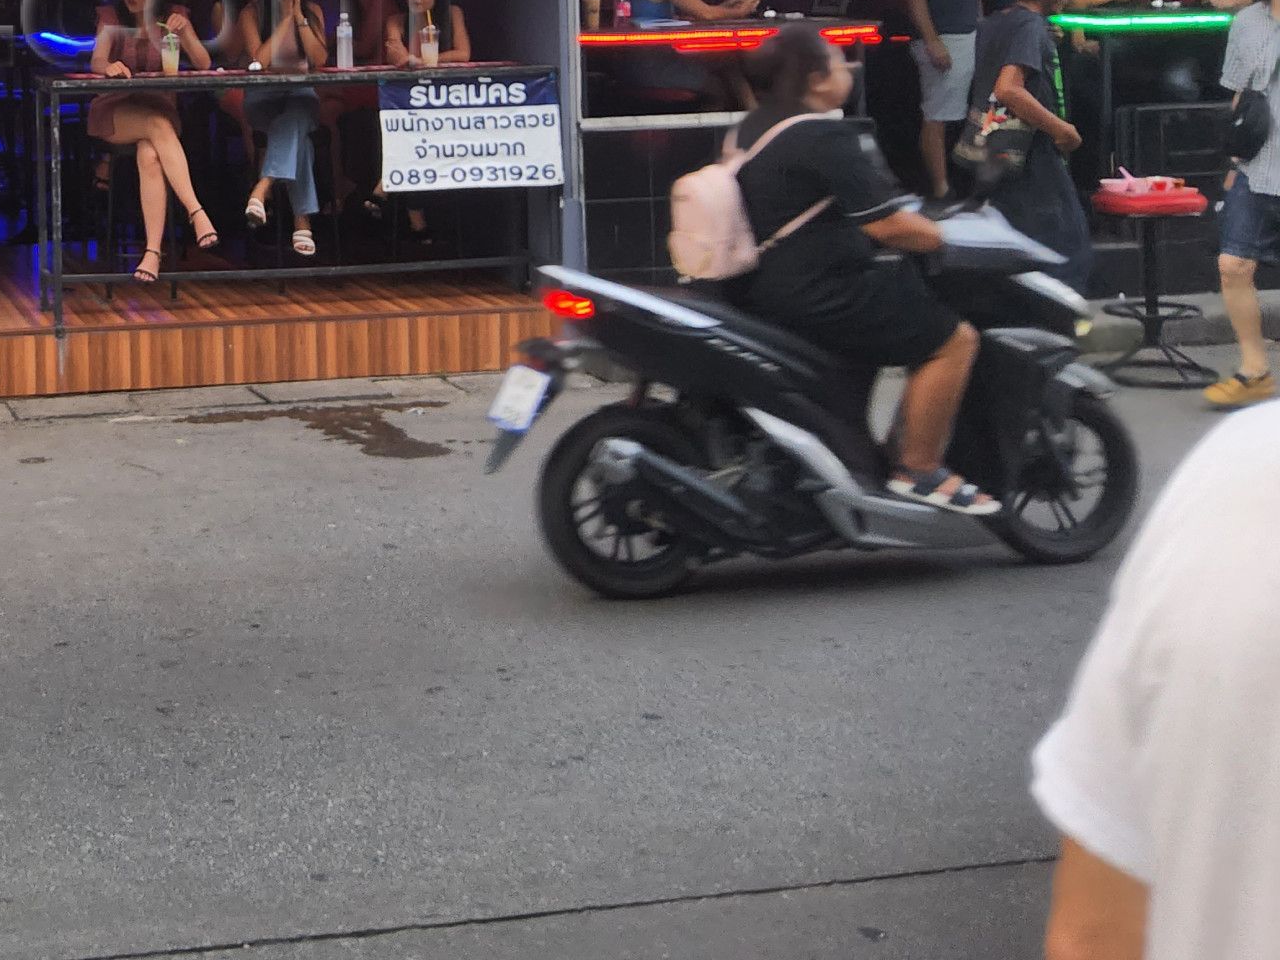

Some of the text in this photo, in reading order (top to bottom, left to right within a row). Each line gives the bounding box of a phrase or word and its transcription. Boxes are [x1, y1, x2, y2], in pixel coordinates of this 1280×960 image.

[409, 76, 527, 107] รับสมัคร
[385, 111, 556, 133] พนักงานสาวสวย
[414, 138, 526, 160] จำนวนมาก
[389, 164, 557, 186] 089-0931926
